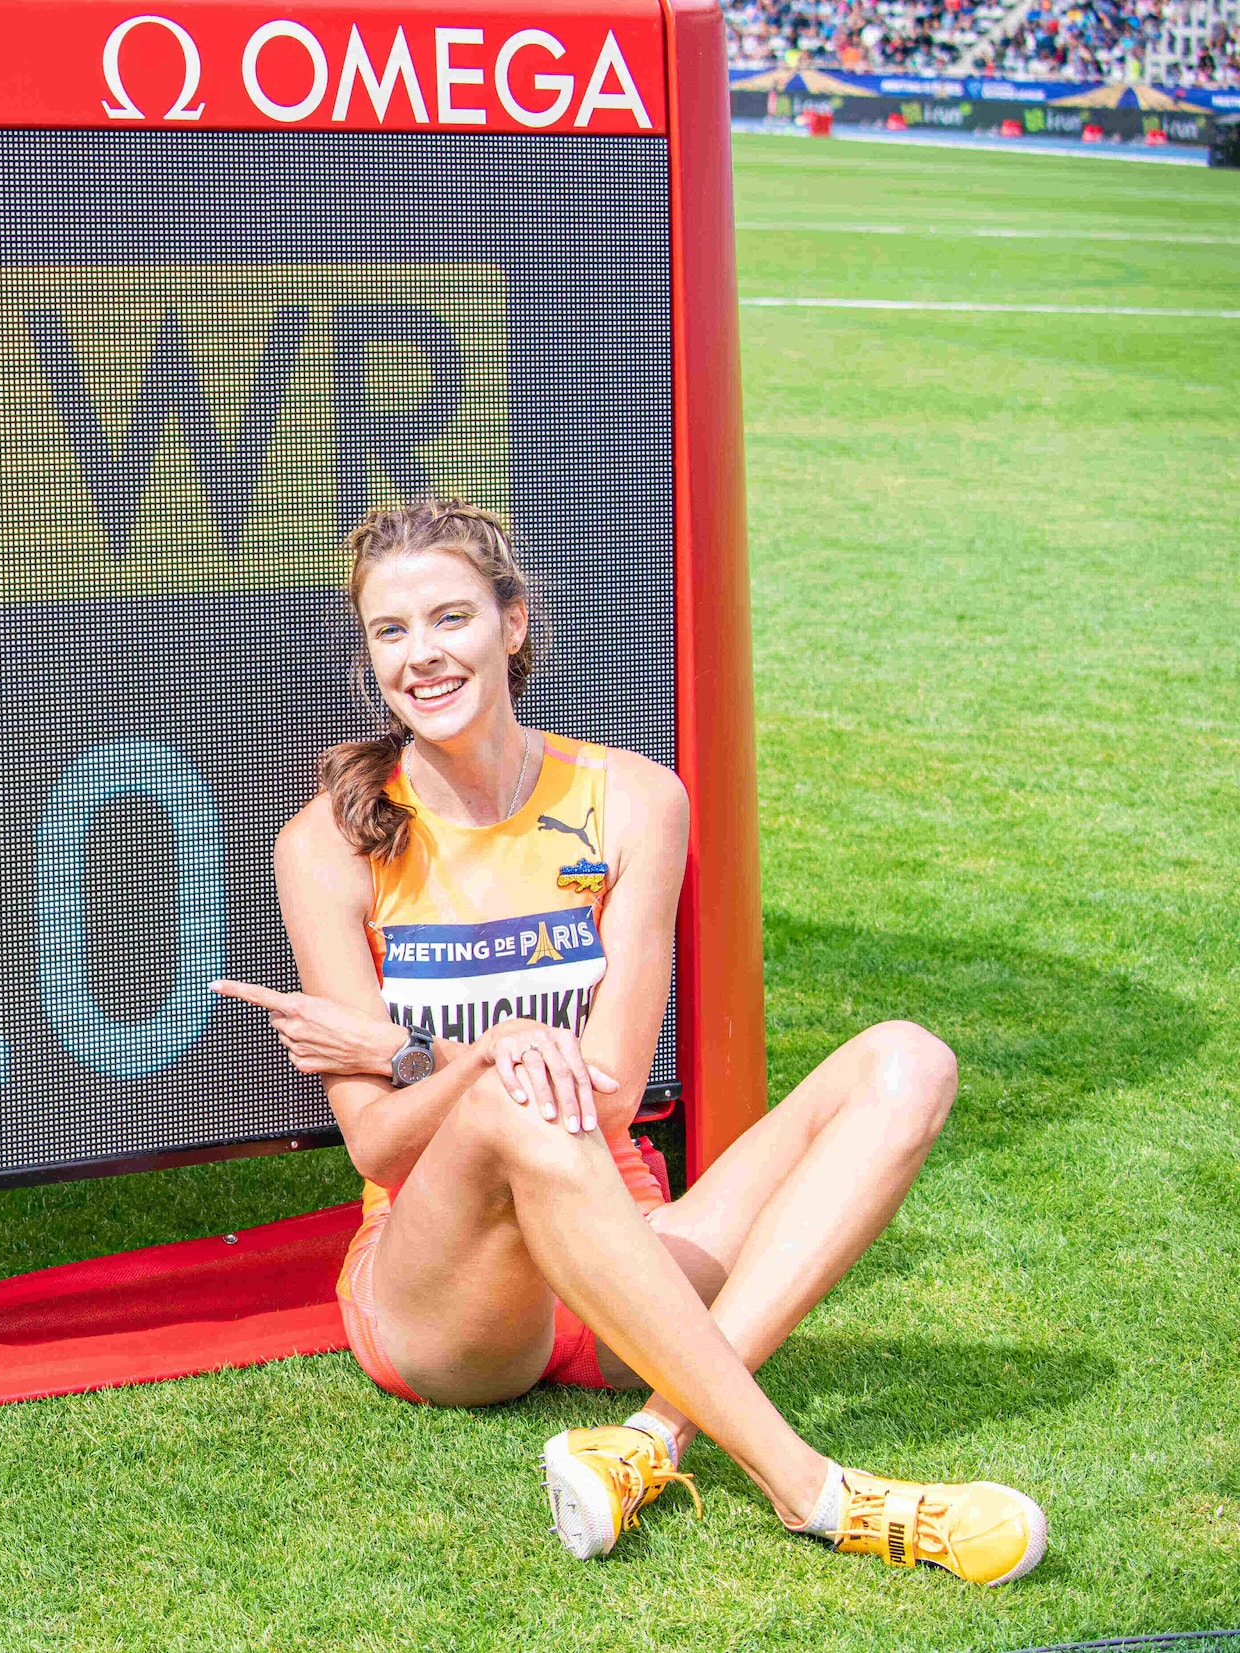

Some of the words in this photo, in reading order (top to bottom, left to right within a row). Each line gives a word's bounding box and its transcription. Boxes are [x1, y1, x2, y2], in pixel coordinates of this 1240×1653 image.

[242, 18, 653, 129] OMEGA
[22, 302, 464, 562] WR
[387, 940, 490, 962] MEETING
[494, 935, 516, 957] DE
[519, 920, 595, 965] PARIS
[888, 1521, 907, 1565] PUMA
